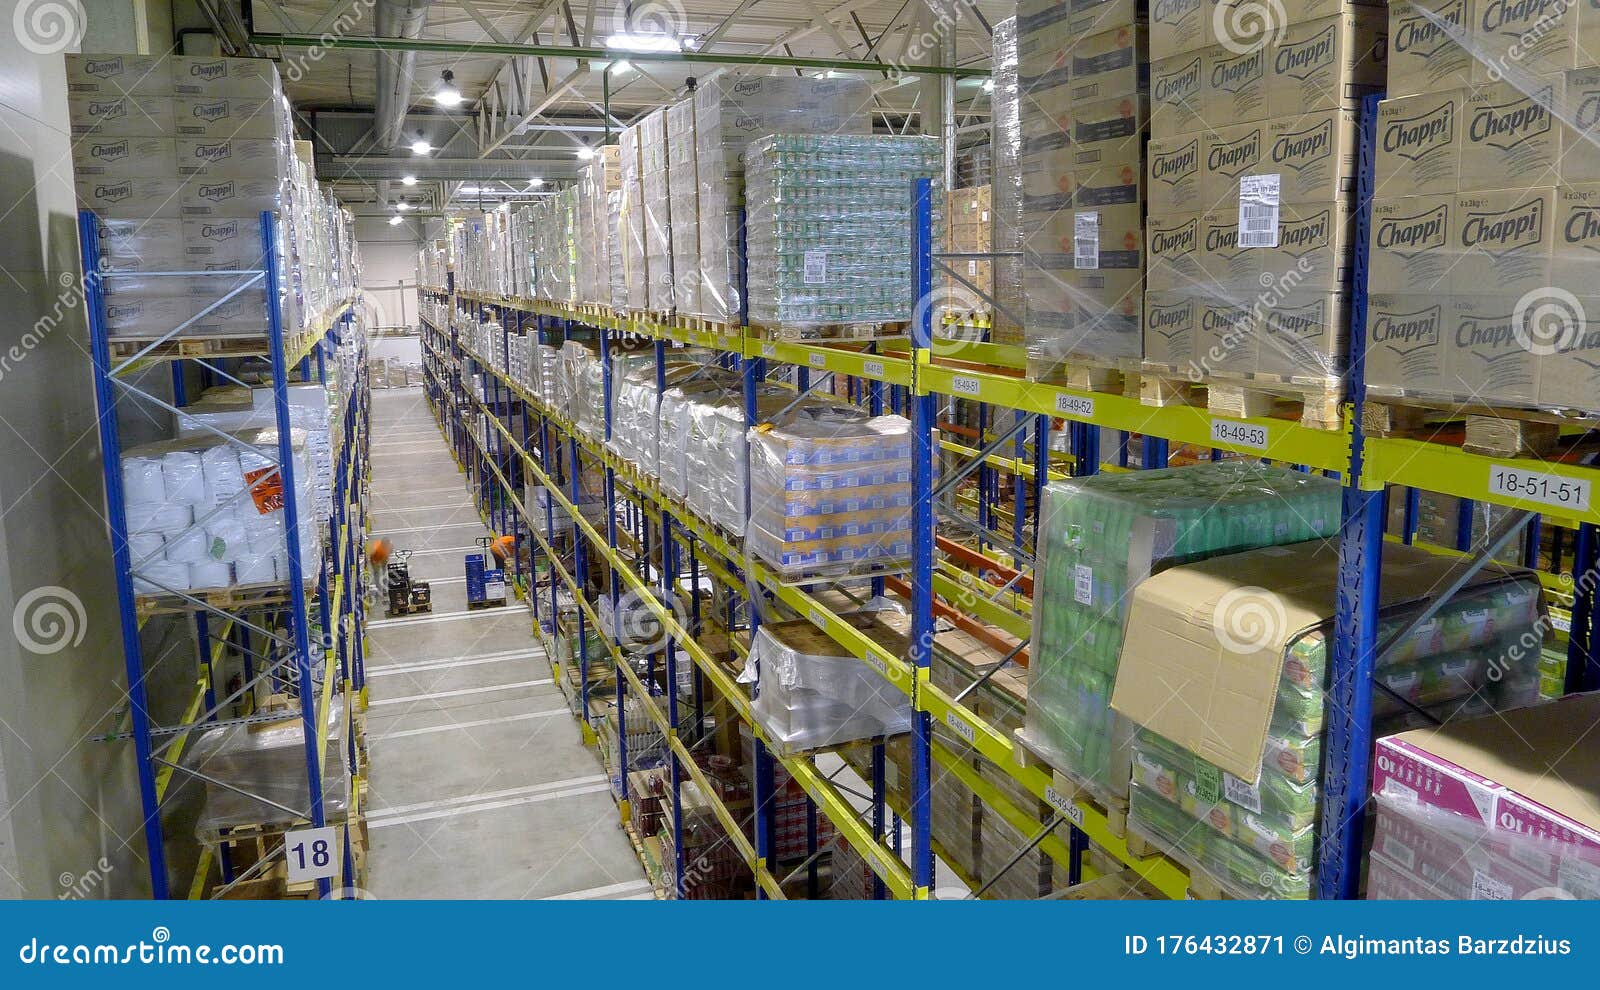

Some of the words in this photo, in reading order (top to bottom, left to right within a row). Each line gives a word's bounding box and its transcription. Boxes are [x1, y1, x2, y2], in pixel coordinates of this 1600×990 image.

[1275, 31, 1331, 74] Chappi
[1155, 64, 1198, 101] Chappi
[1211, 52, 1259, 88] Chappi
[1384, 109, 1448, 152] Chappi
[1469, 94, 1548, 142] Chappi
[91, 142, 125, 157] Chappi
[1208, 136, 1257, 171] Chappi
[1272, 126, 1328, 163] Chappi
[1152, 146, 1195, 179] Chappi
[95, 186, 129, 198] Chappi
[198, 184, 232, 198] Chappi
[1152, 225, 1194, 254] Chappi
[1376, 212, 1443, 248] Chappi
[1461, 206, 1538, 247] Chappi
[1149, 303, 1191, 330] Chappi
[1372, 312, 1437, 343] Chappi
[1058, 397, 1092, 415] 18-49-52
[1215, 423, 1265, 445] 18-49-53
[1496, 471, 1582, 505] 18-51-51
[1047, 789, 1079, 819] 18-49-42
[291, 839, 330, 870] 18
